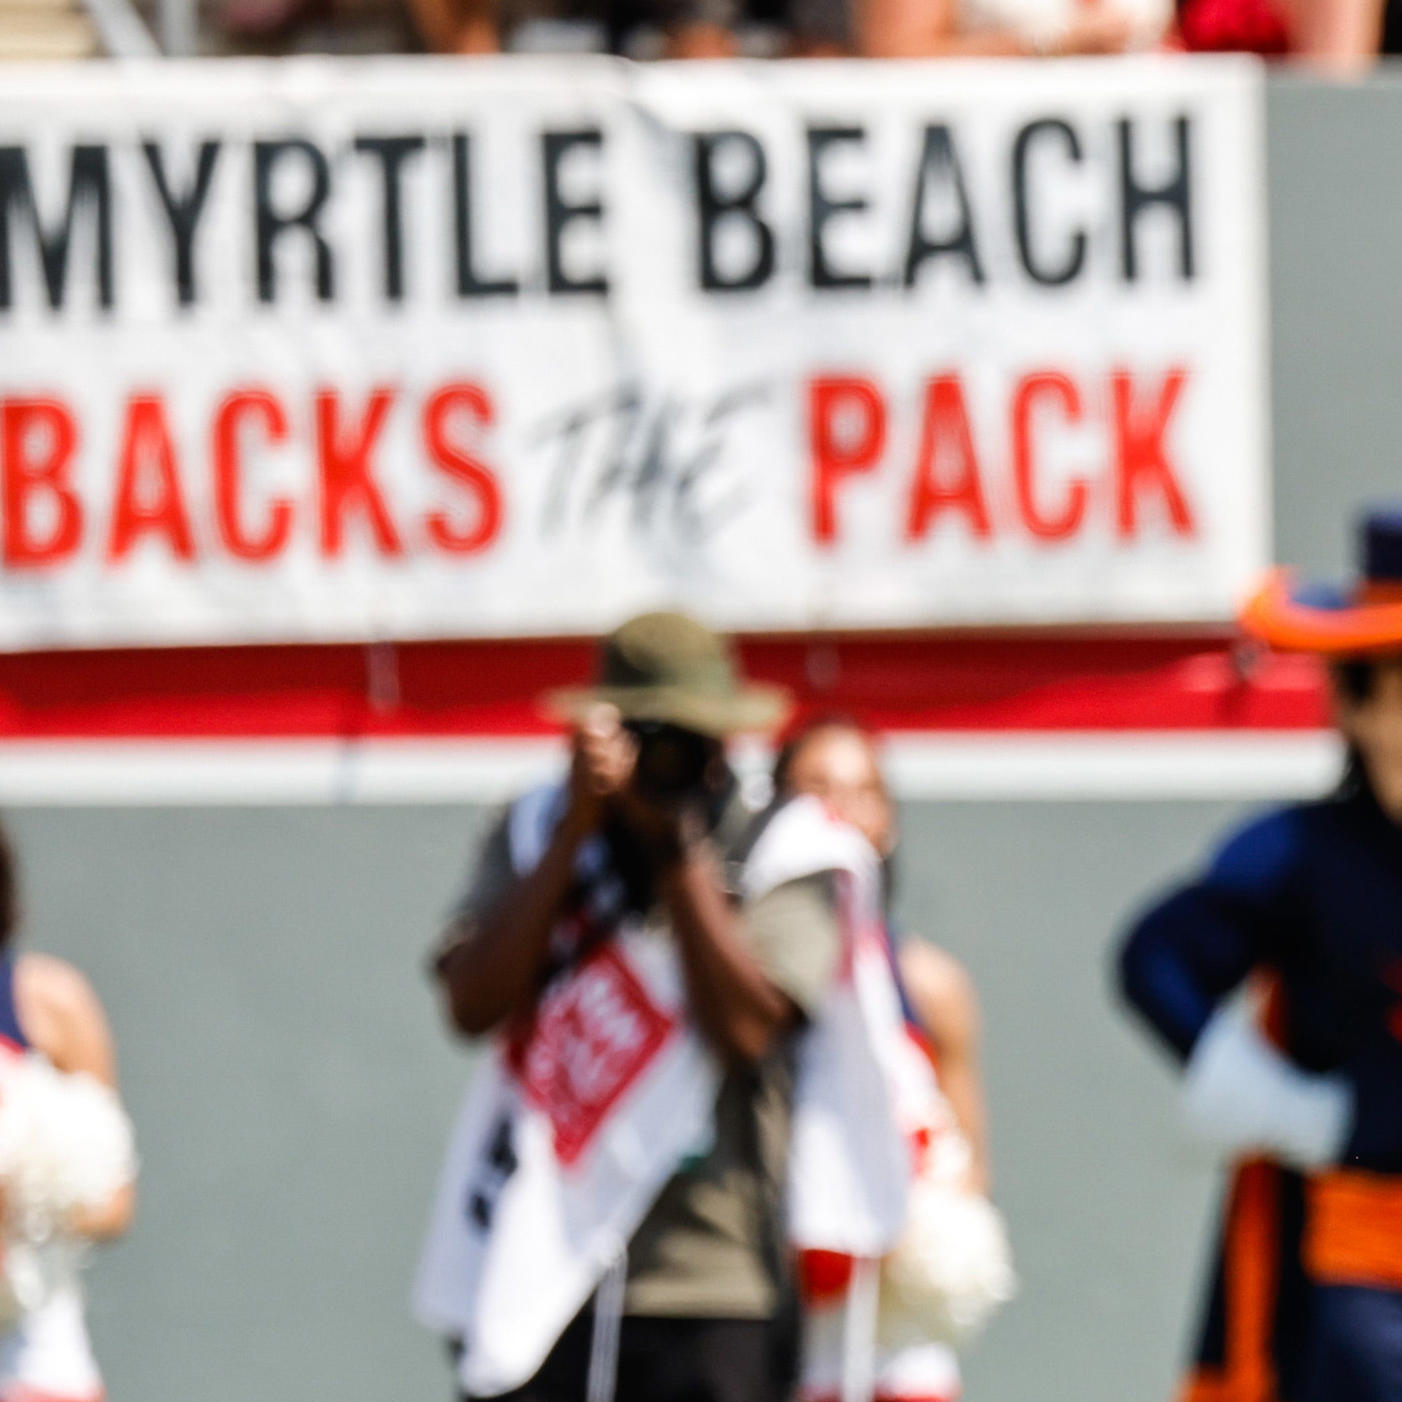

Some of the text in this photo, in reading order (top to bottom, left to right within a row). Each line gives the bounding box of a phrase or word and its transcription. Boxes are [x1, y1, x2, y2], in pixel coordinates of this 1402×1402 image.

[0, 115, 1197, 310] MYRTLE BEACH
[0, 365, 1194, 567] BACKS THE PACK
